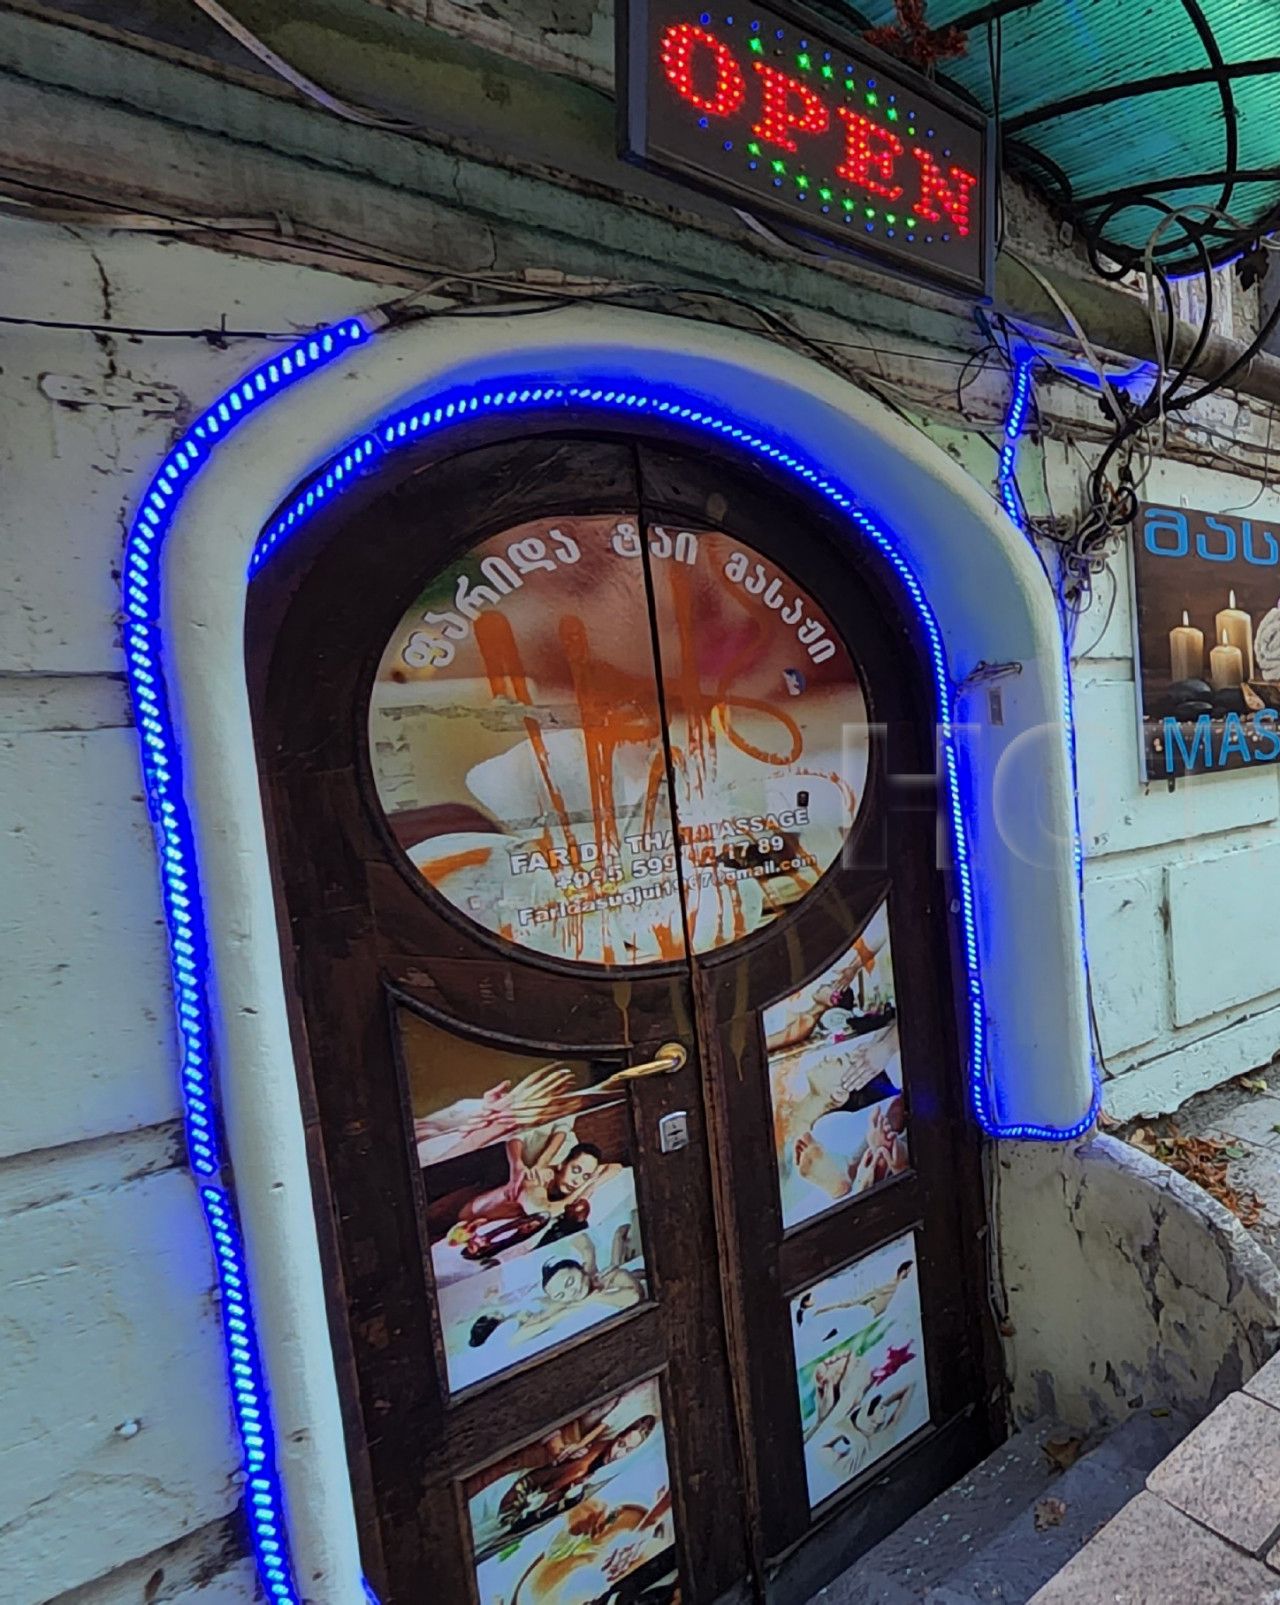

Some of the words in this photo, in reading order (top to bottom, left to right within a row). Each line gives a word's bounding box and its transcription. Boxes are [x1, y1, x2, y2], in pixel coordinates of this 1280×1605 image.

[660, 22, 977, 237] OPEN
[402, 529, 581, 669] ფარიდა
[611, 523, 699, 566] ტაი
[723, 551, 836, 664] მასაჟი
[509, 836, 622, 876] FARIDA
[632, 852, 678, 879] 599
[757, 834, 785, 856] 89
